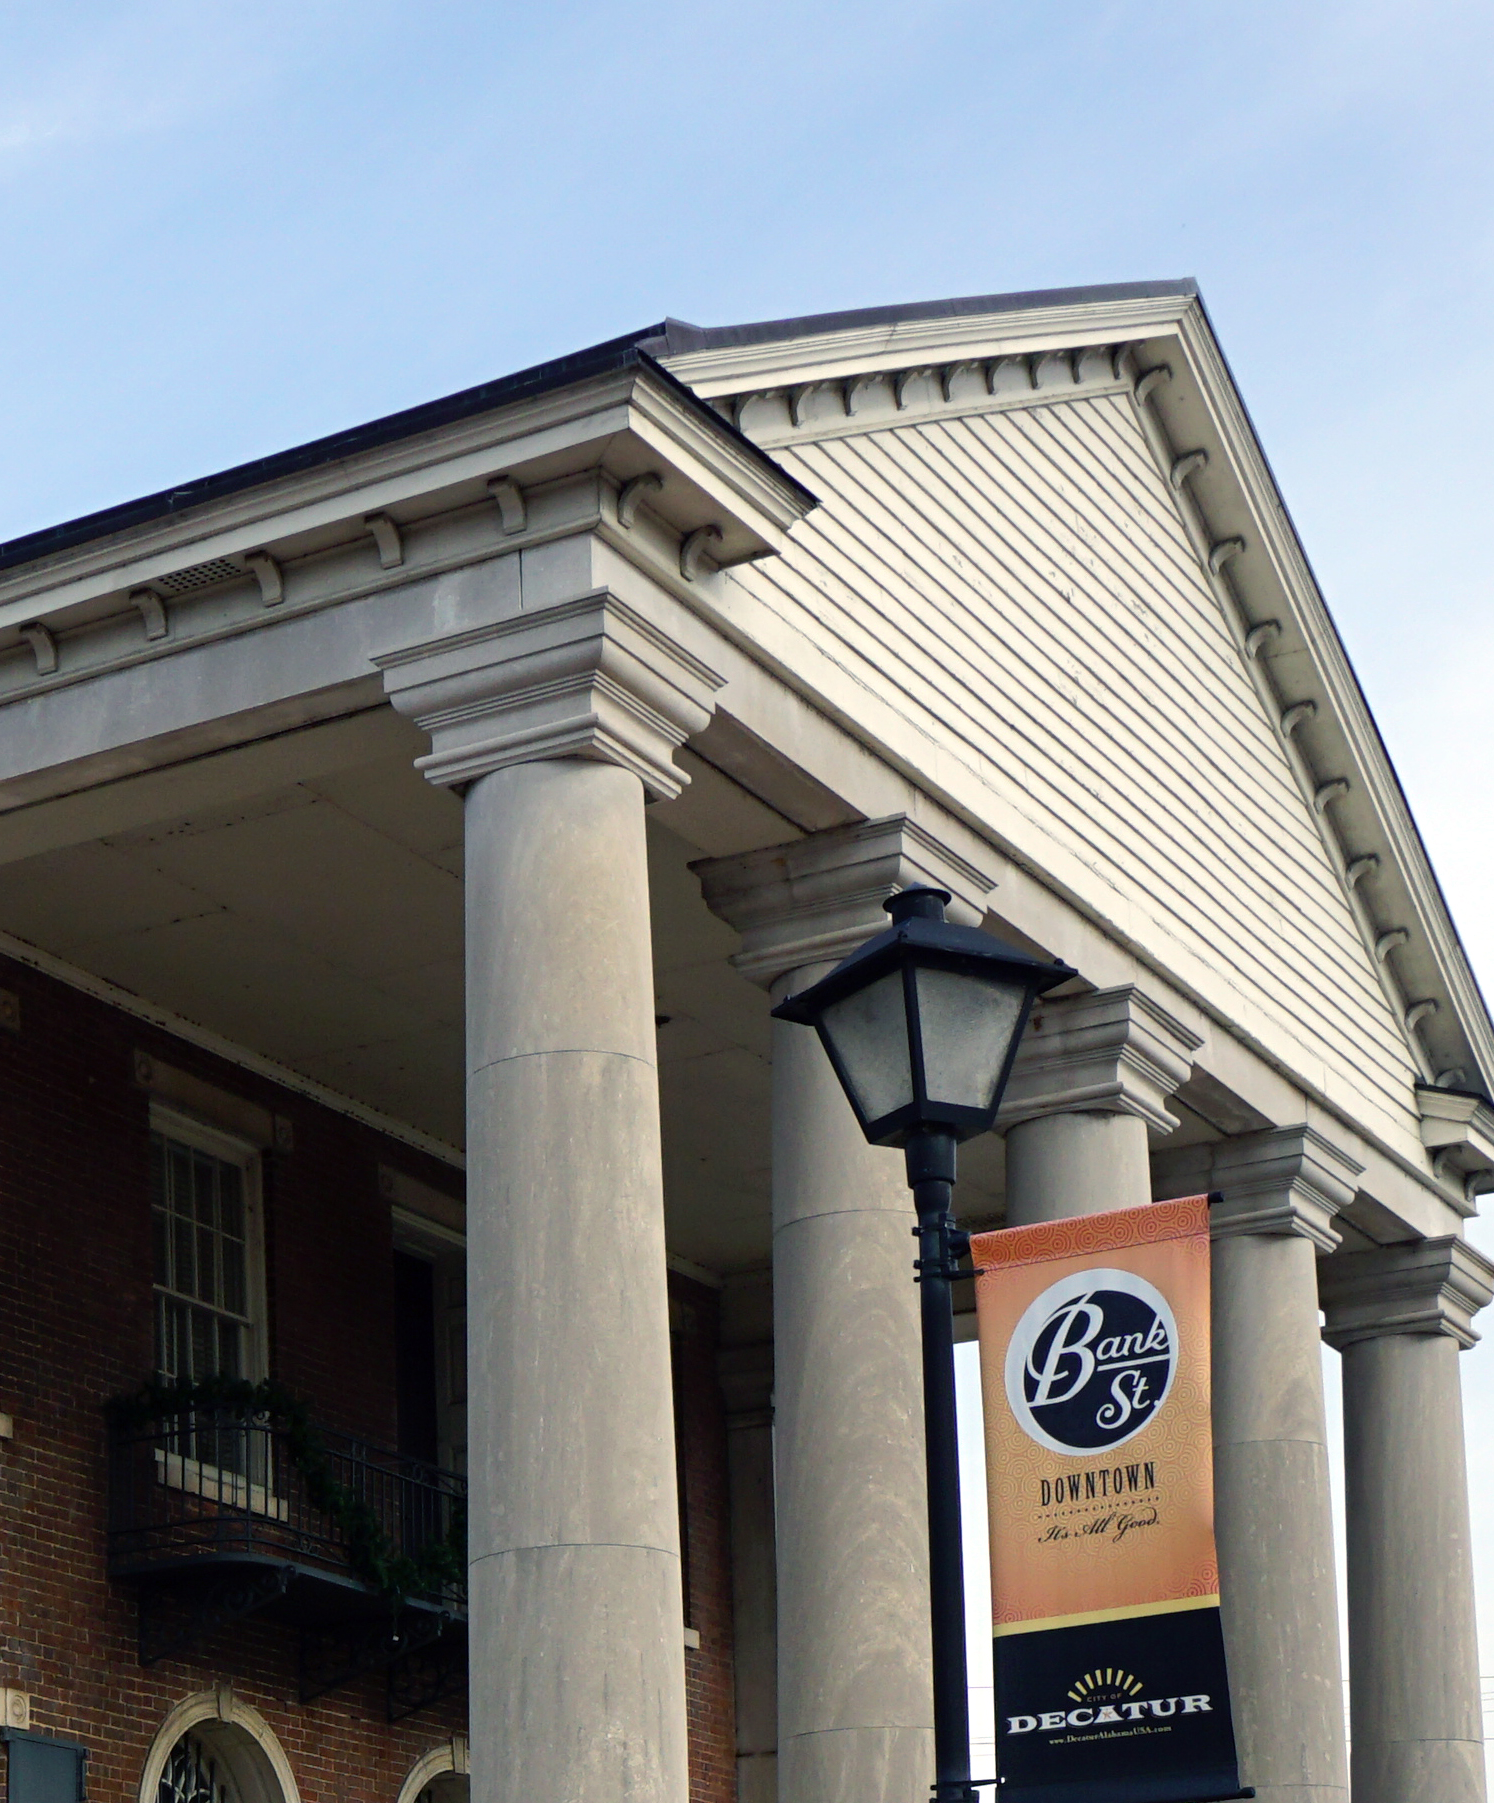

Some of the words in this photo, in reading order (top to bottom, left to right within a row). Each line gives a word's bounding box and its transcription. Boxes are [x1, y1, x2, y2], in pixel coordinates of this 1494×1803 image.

[1027, 1291, 1170, 1407] Bank
[1096, 1370, 1161, 1429] St.
[1041, 1462, 1154, 1506] DOWNTOWN
[1038, 1526, 1072, 1543] It's
[1075, 1511, 1116, 1538] All
[1112, 1507, 1160, 1543] Good.
[1007, 1694, 1213, 1734] DECATUR
[1049, 1725, 1172, 1745] www.DecaturAlabamaUSA.com
